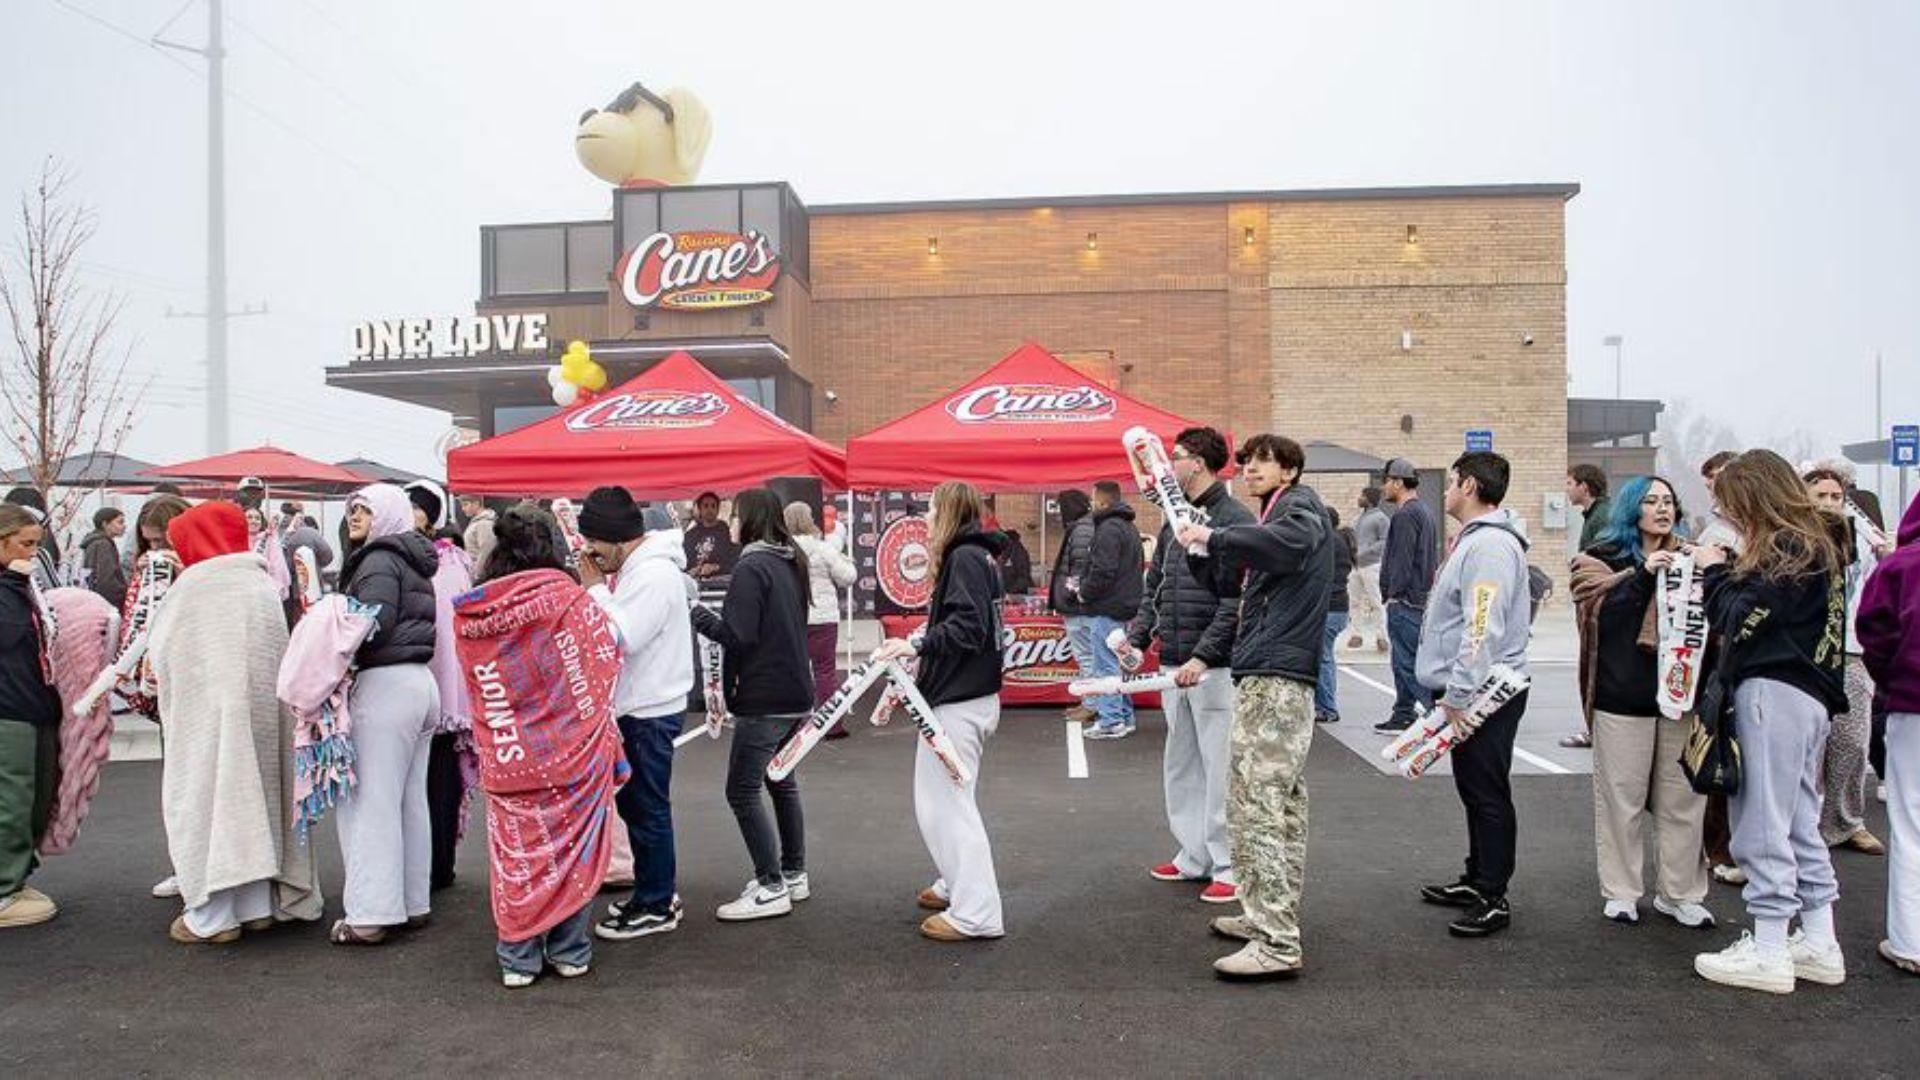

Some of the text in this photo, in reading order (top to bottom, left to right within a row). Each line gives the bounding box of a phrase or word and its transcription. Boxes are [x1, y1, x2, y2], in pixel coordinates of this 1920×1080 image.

[623, 230, 776, 305] Cane's
[350, 312, 548, 361] ONE LOVE
[567, 392, 724, 429] Cane's
[956, 386, 1112, 421] Cane's
[1002, 628, 1072, 672] ane
[1684, 610, 1706, 649] ONE
[473, 661, 525, 763] SENIOR
